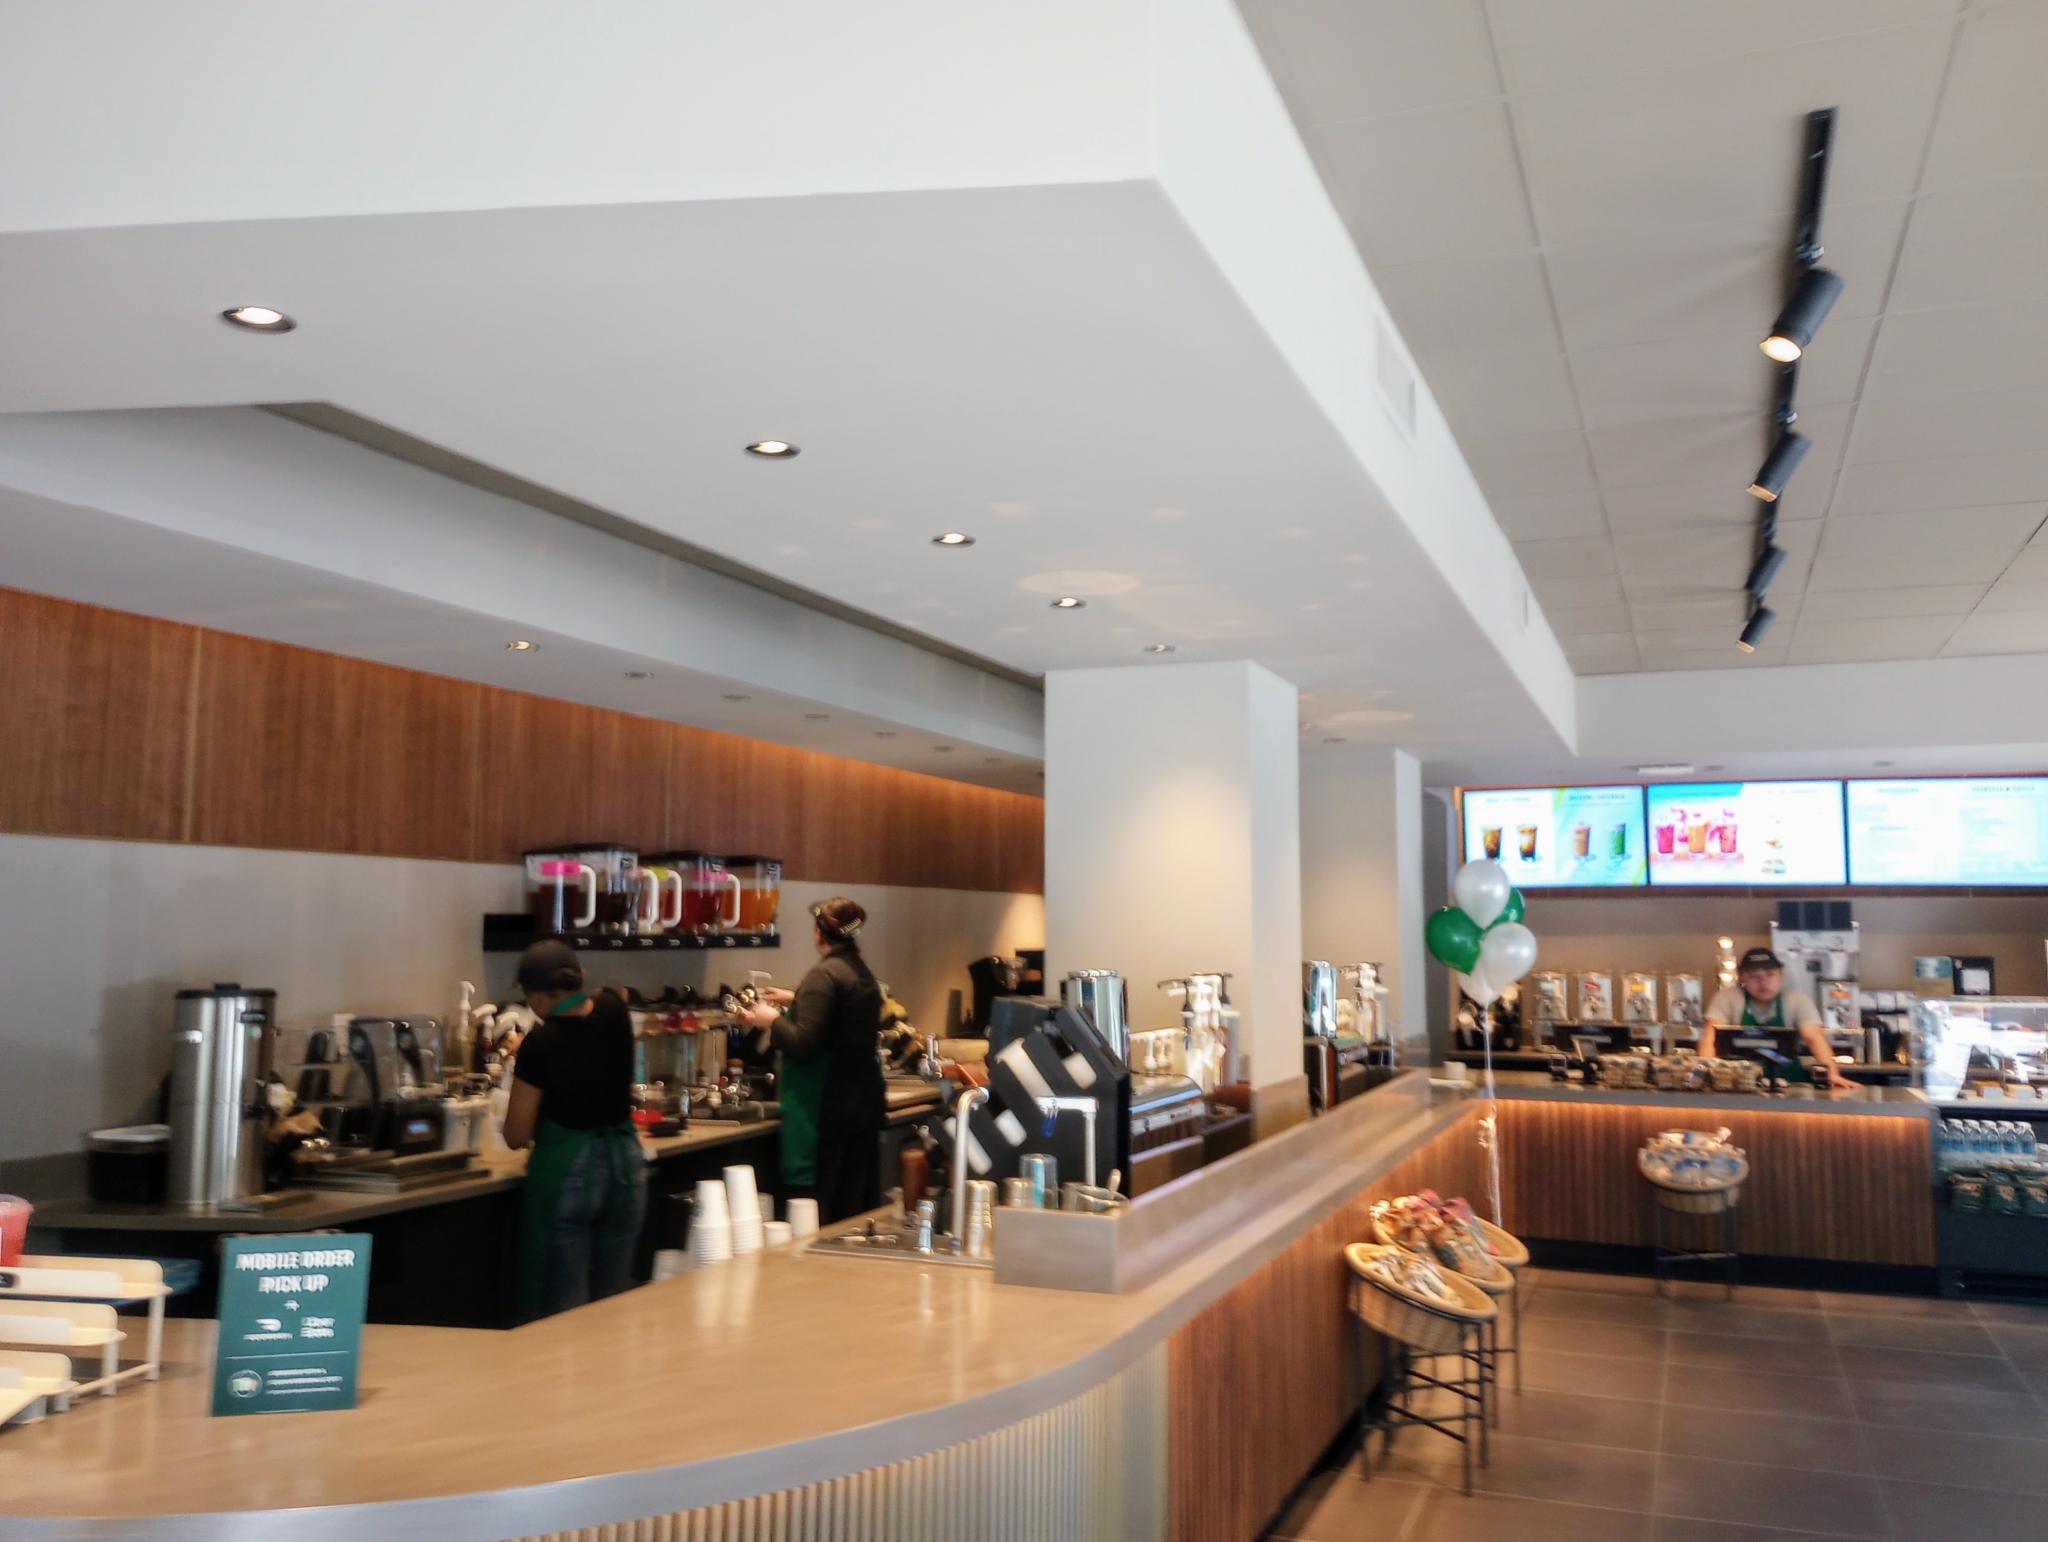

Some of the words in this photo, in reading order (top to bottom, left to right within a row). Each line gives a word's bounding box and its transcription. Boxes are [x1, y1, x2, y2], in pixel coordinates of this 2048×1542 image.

[236, 1252, 299, 1271] MOBILE
[300, 1249, 355, 1268] ORDER
[259, 1275, 302, 1294] PICK
[302, 1274, 329, 1292] UP
